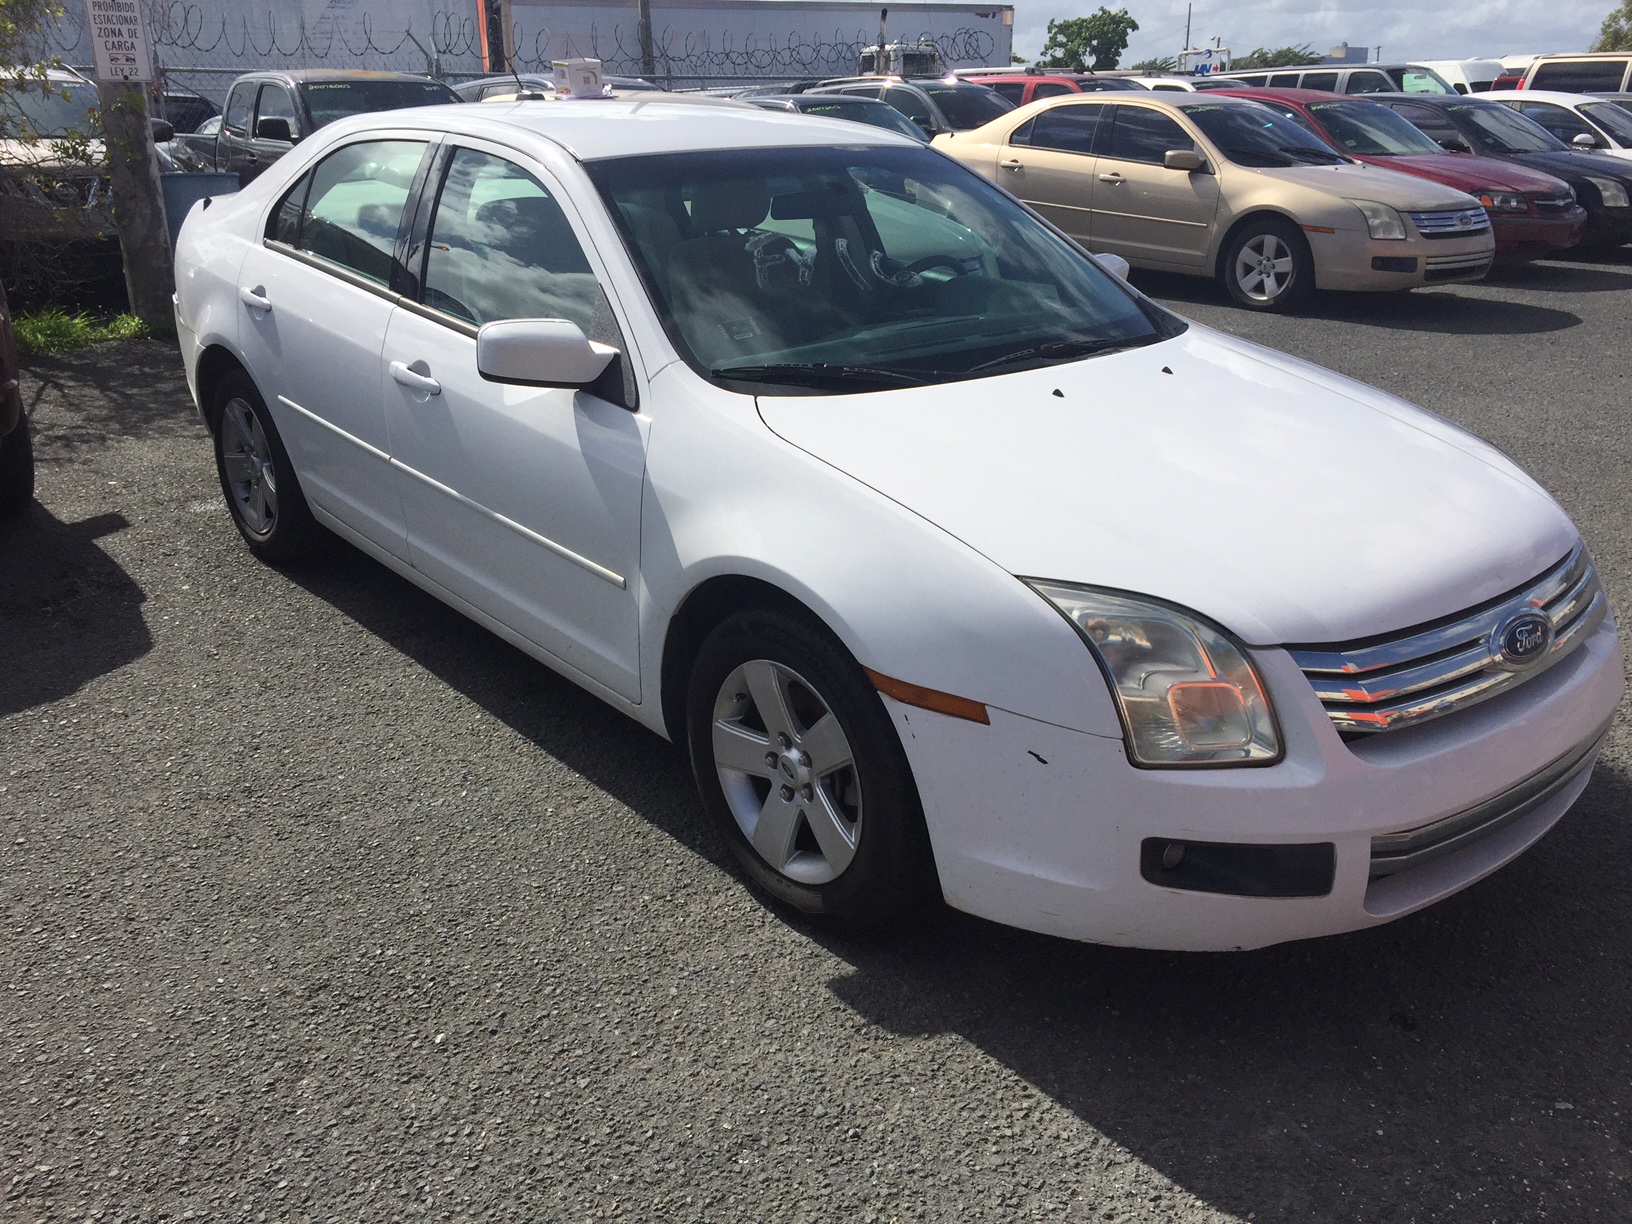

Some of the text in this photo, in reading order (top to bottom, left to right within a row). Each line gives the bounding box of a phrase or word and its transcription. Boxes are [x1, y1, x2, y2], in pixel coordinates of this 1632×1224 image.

[92, 1, 136, 13] PROHIBIDO
[92, 14, 138, 26] ESTACIONAR
[97, 27, 139, 39] ZONA DE
[105, 40, 136, 52] CARGA
[110, 67, 139, 77] LEY 22
[1515, 623, 1542, 653] Ford
